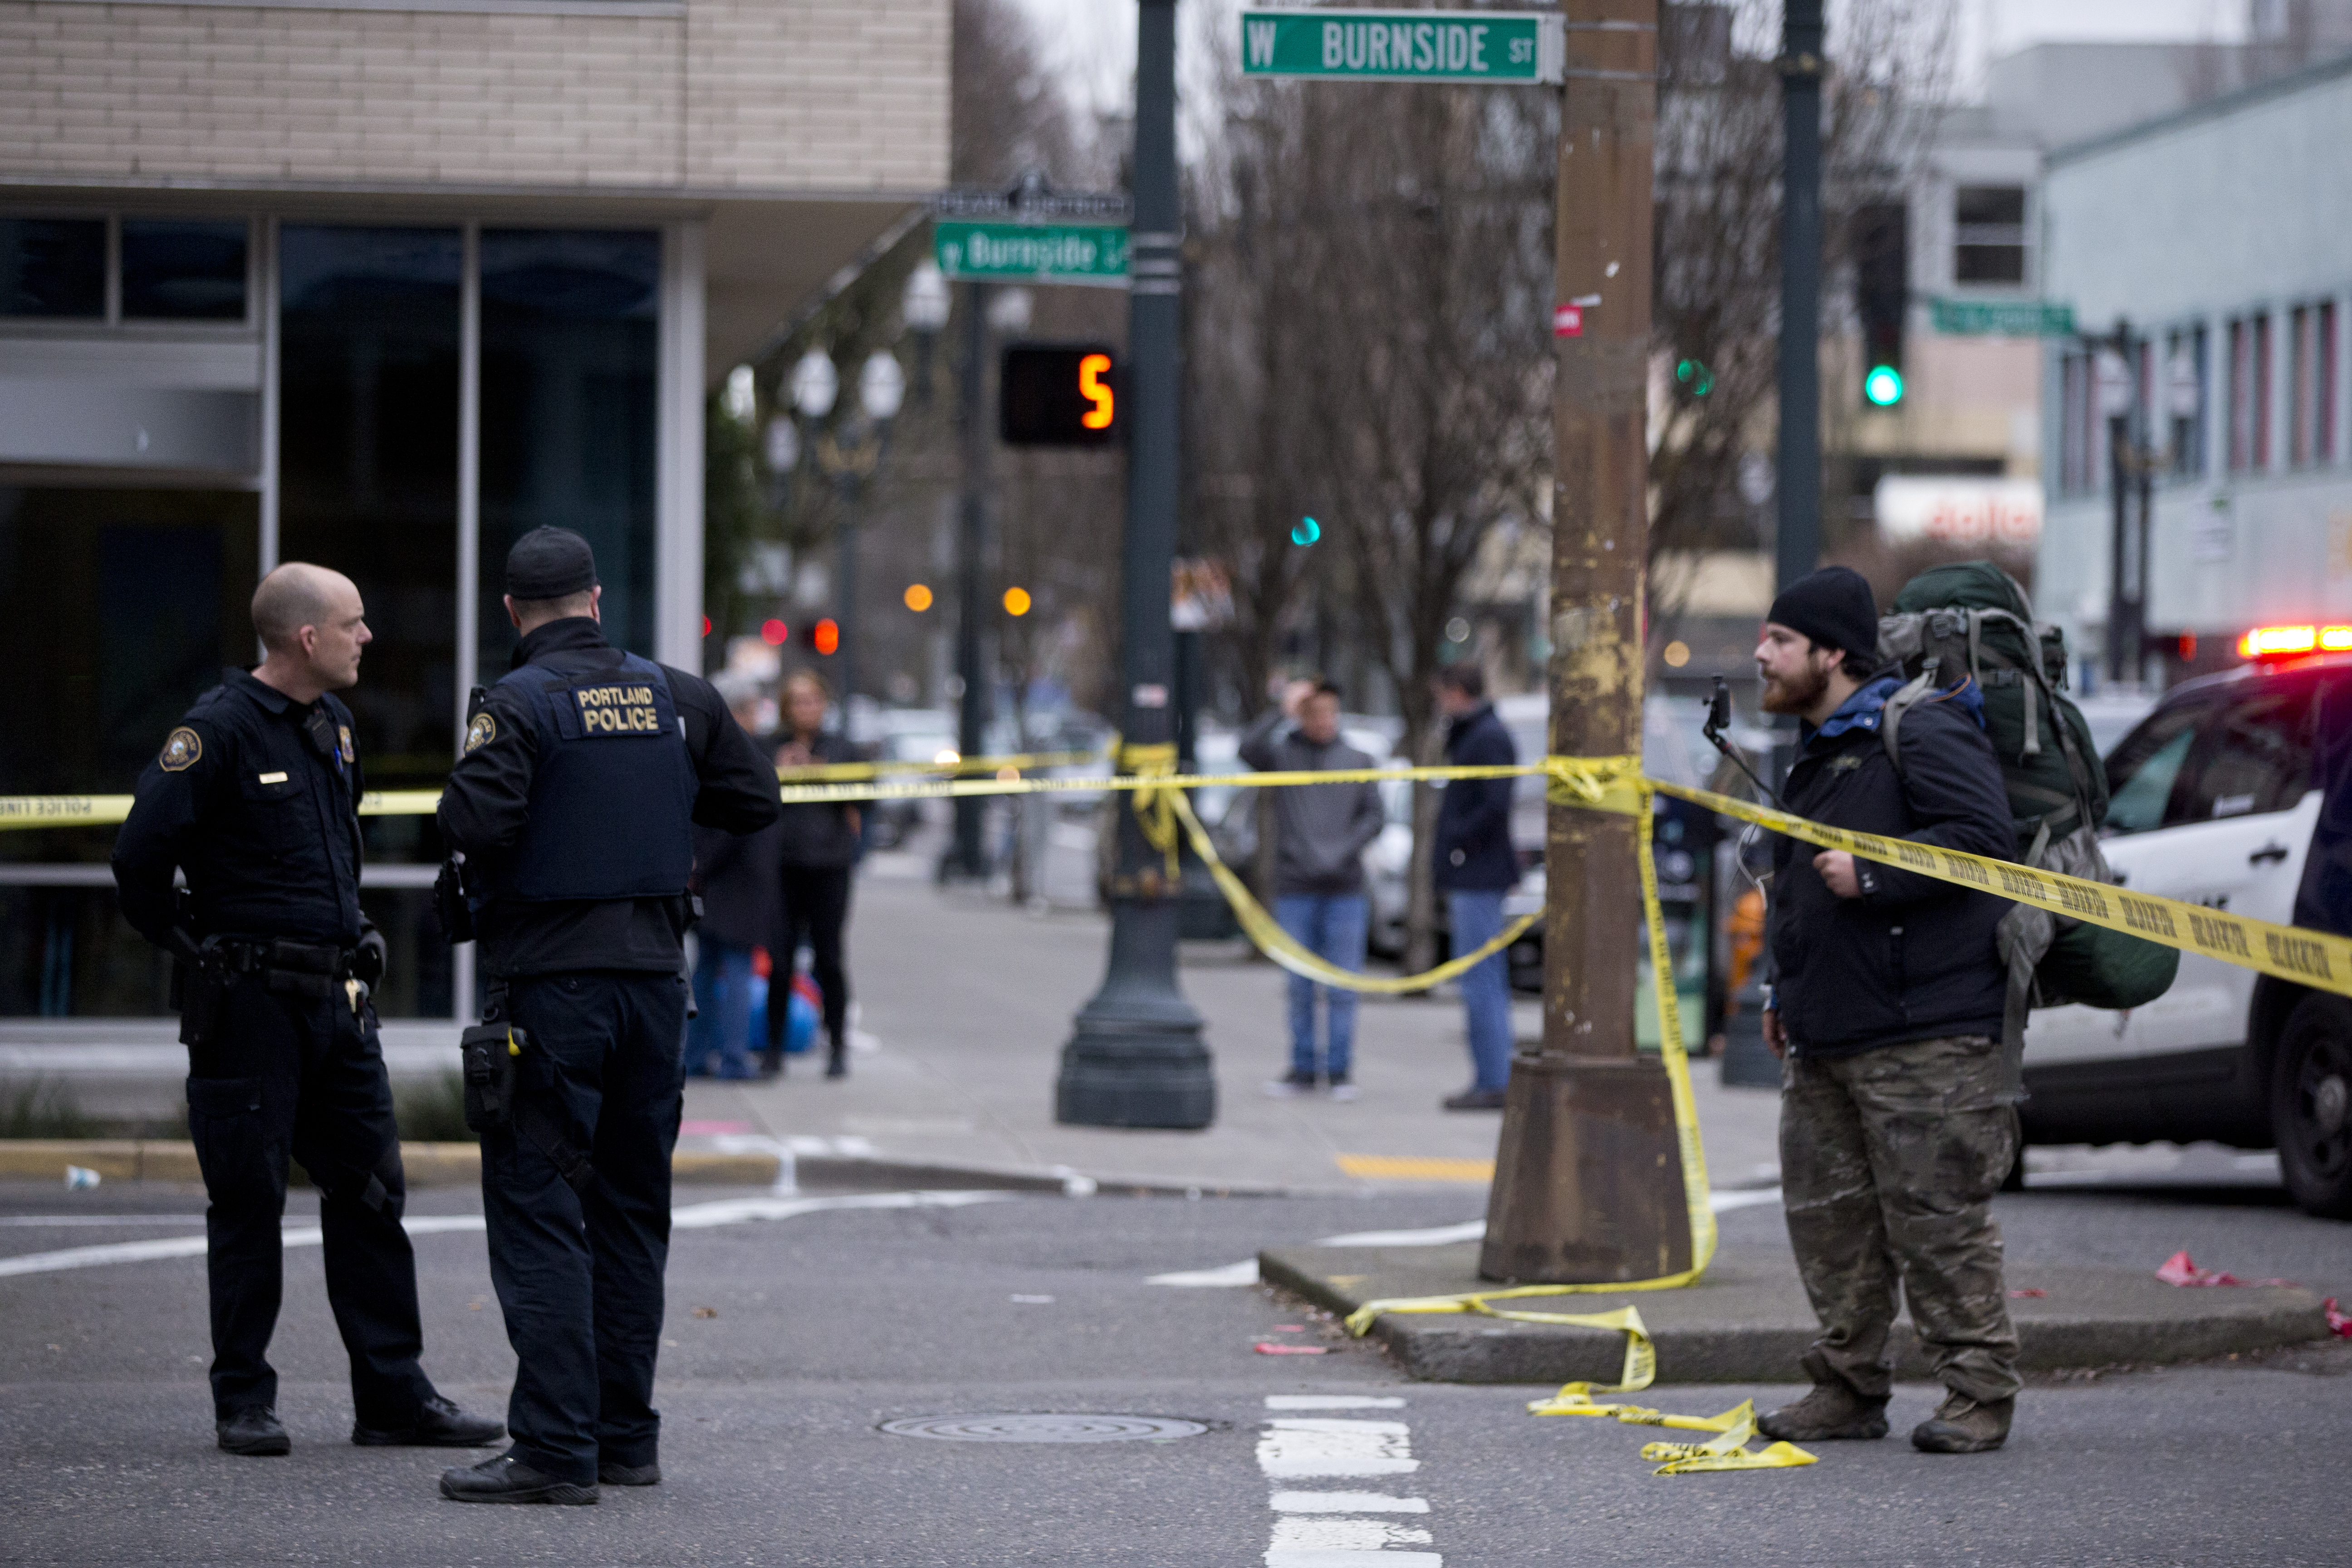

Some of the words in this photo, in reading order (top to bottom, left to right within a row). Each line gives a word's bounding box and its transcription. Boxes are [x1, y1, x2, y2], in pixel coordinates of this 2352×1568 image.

[1247, 20, 1277, 68] W
[1322, 21, 1490, 71] BURNSIDE
[1509, 37, 1534, 64] ST
[967, 231, 1097, 272] Burnside
[1079, 353, 1114, 429] 5
[578, 686, 653, 708] PORTLAND
[583, 707, 659, 733] POLICE
